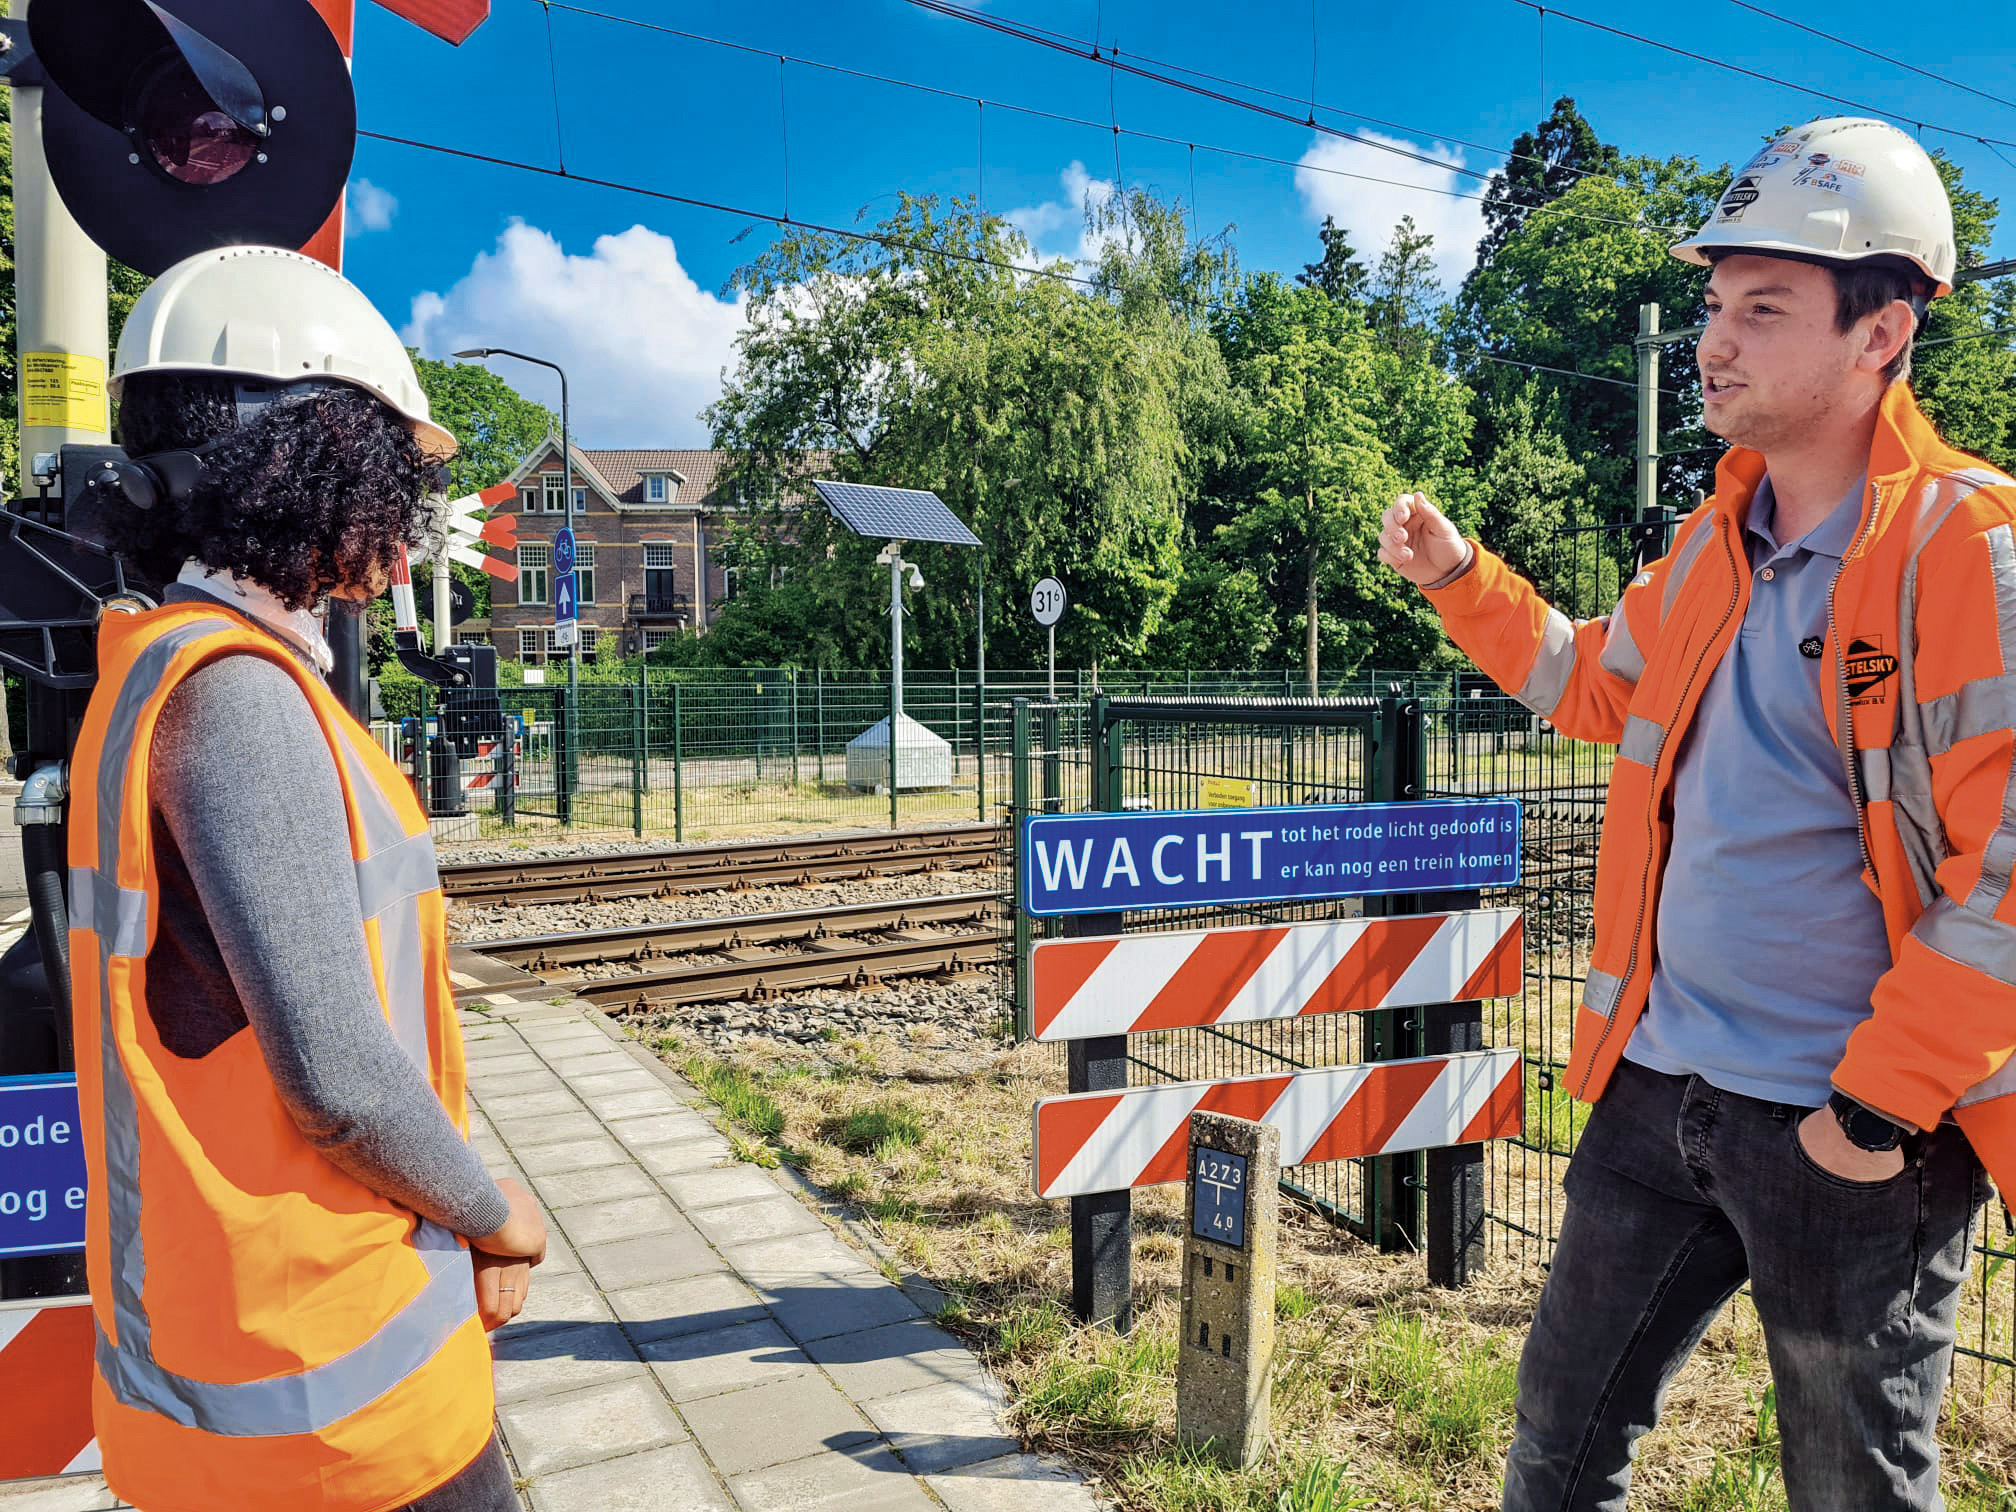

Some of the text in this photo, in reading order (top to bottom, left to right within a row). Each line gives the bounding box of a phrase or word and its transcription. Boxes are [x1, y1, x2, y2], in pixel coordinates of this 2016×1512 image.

[1280, 817, 1512, 843] tot het rode licht gedoofd is
[1034, 830, 1273, 892] WACHT
[1280, 852, 1513, 878] er kan nog een trein komen
[1198, 1159, 1241, 1184] A273
